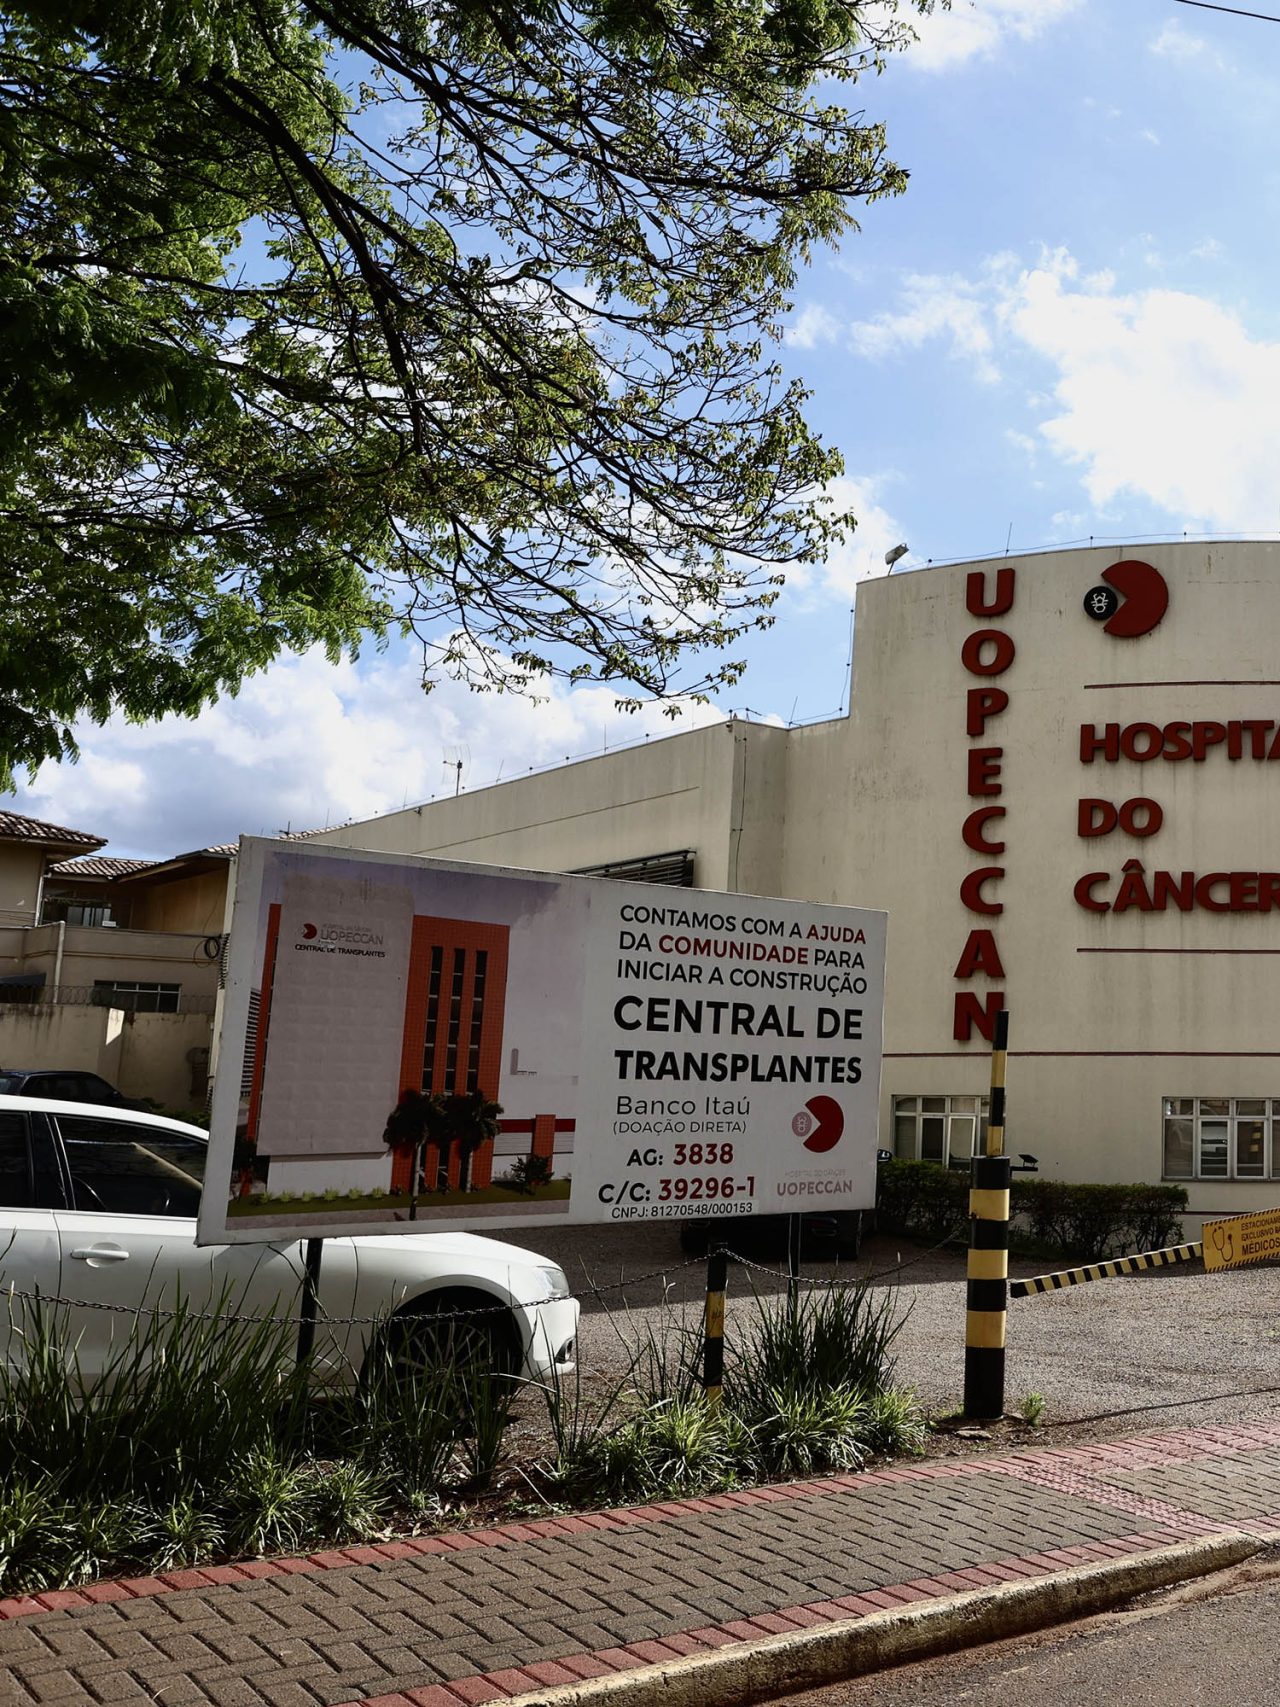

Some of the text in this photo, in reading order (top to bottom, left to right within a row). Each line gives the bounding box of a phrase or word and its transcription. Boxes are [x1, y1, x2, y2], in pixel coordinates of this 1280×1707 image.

[953, 568, 1016, 1042] UOPECCAN
[1077, 797, 1164, 838] DO
[620, 904, 866, 944] CONTAMOS COM A AJUDA
[321, 928, 384, 945] UOPECCAN
[295, 944, 325, 953] CENTRAL
[338, 947, 385, 957] TRANSPLANTES
[619, 931, 865, 969] DA COMUNIDADE PARA
[617, 959, 868, 997] INICIAR A CONSTRUÇÃO
[613, 995, 863, 1040] CENTRAL DE
[614, 1049, 862, 1084] TRANSPLANTES
[616, 1095, 750, 1115] Banco Itaú
[612, 1119, 747, 1136] (DOAÇÃO DIRETA)
[627, 1143, 734, 1166] AG: 3838
[598, 1175, 755, 1204] C/C: 39296-1
[777, 1180, 852, 1196] UOPECCAN
[611, 1202, 753, 1219] CNPJ: 81270548/000153
[1241, 1229, 1274, 1241] EXCLUSIVO
[1242, 1237, 1280, 1256] MÉDICOS
